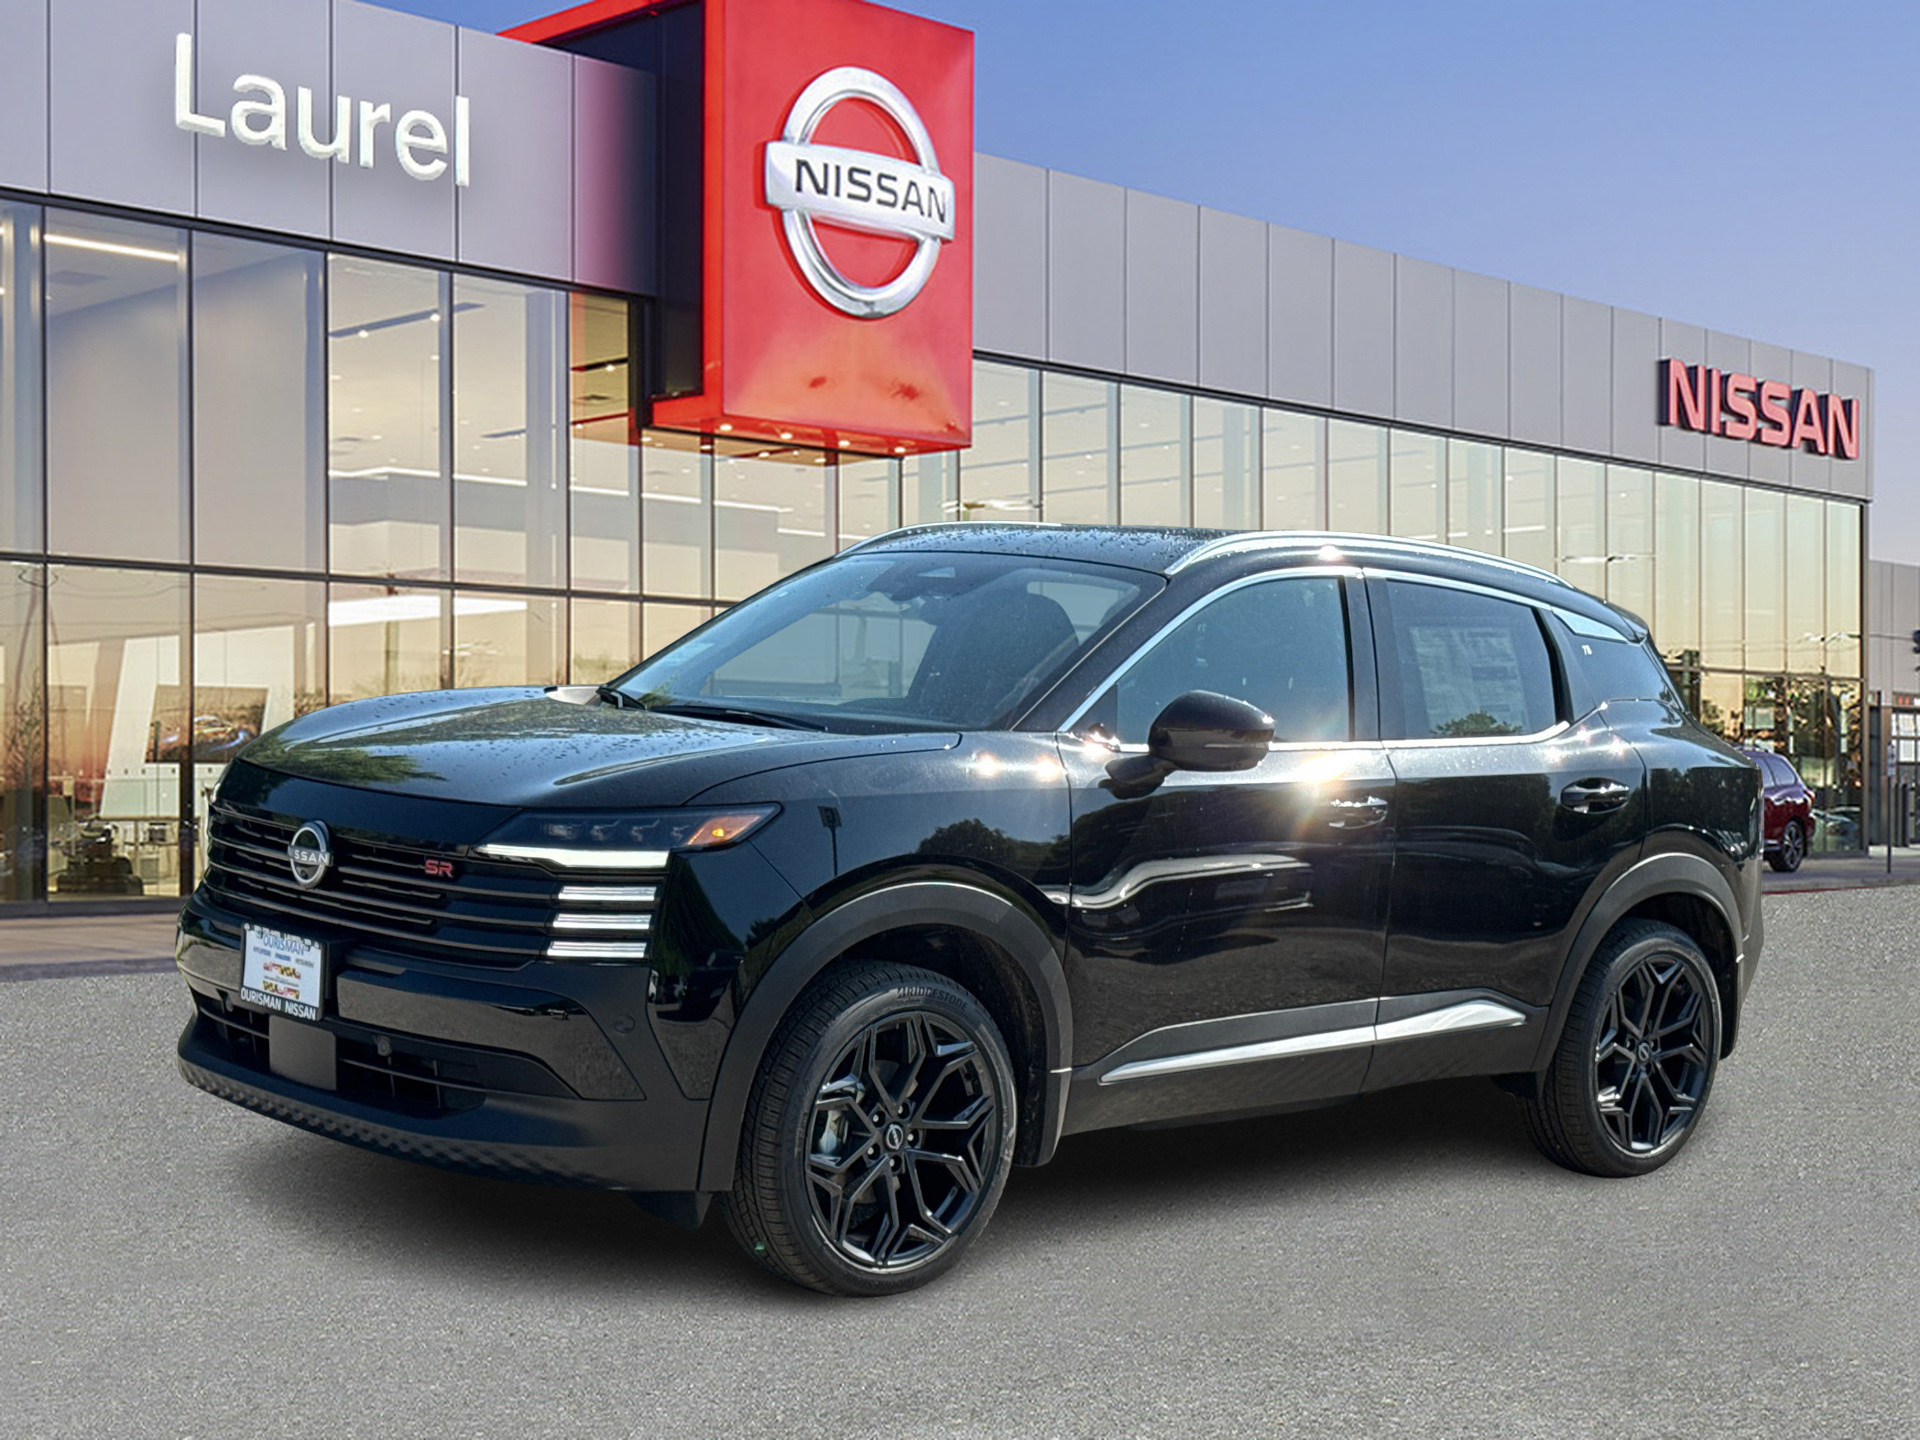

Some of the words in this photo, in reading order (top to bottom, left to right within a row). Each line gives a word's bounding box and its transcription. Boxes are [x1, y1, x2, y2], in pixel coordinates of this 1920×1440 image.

[176, 33, 469, 187] Laurel
[795, 158, 946, 223] NISSAN
[1658, 358, 1860, 460] NISSAN
[425, 859, 454, 878] SR
[240, 987, 282, 1011] OURISMAN
[284, 1000, 317, 1021] NISSAN
[897, 986, 969, 1012] BRIDGESTONE
